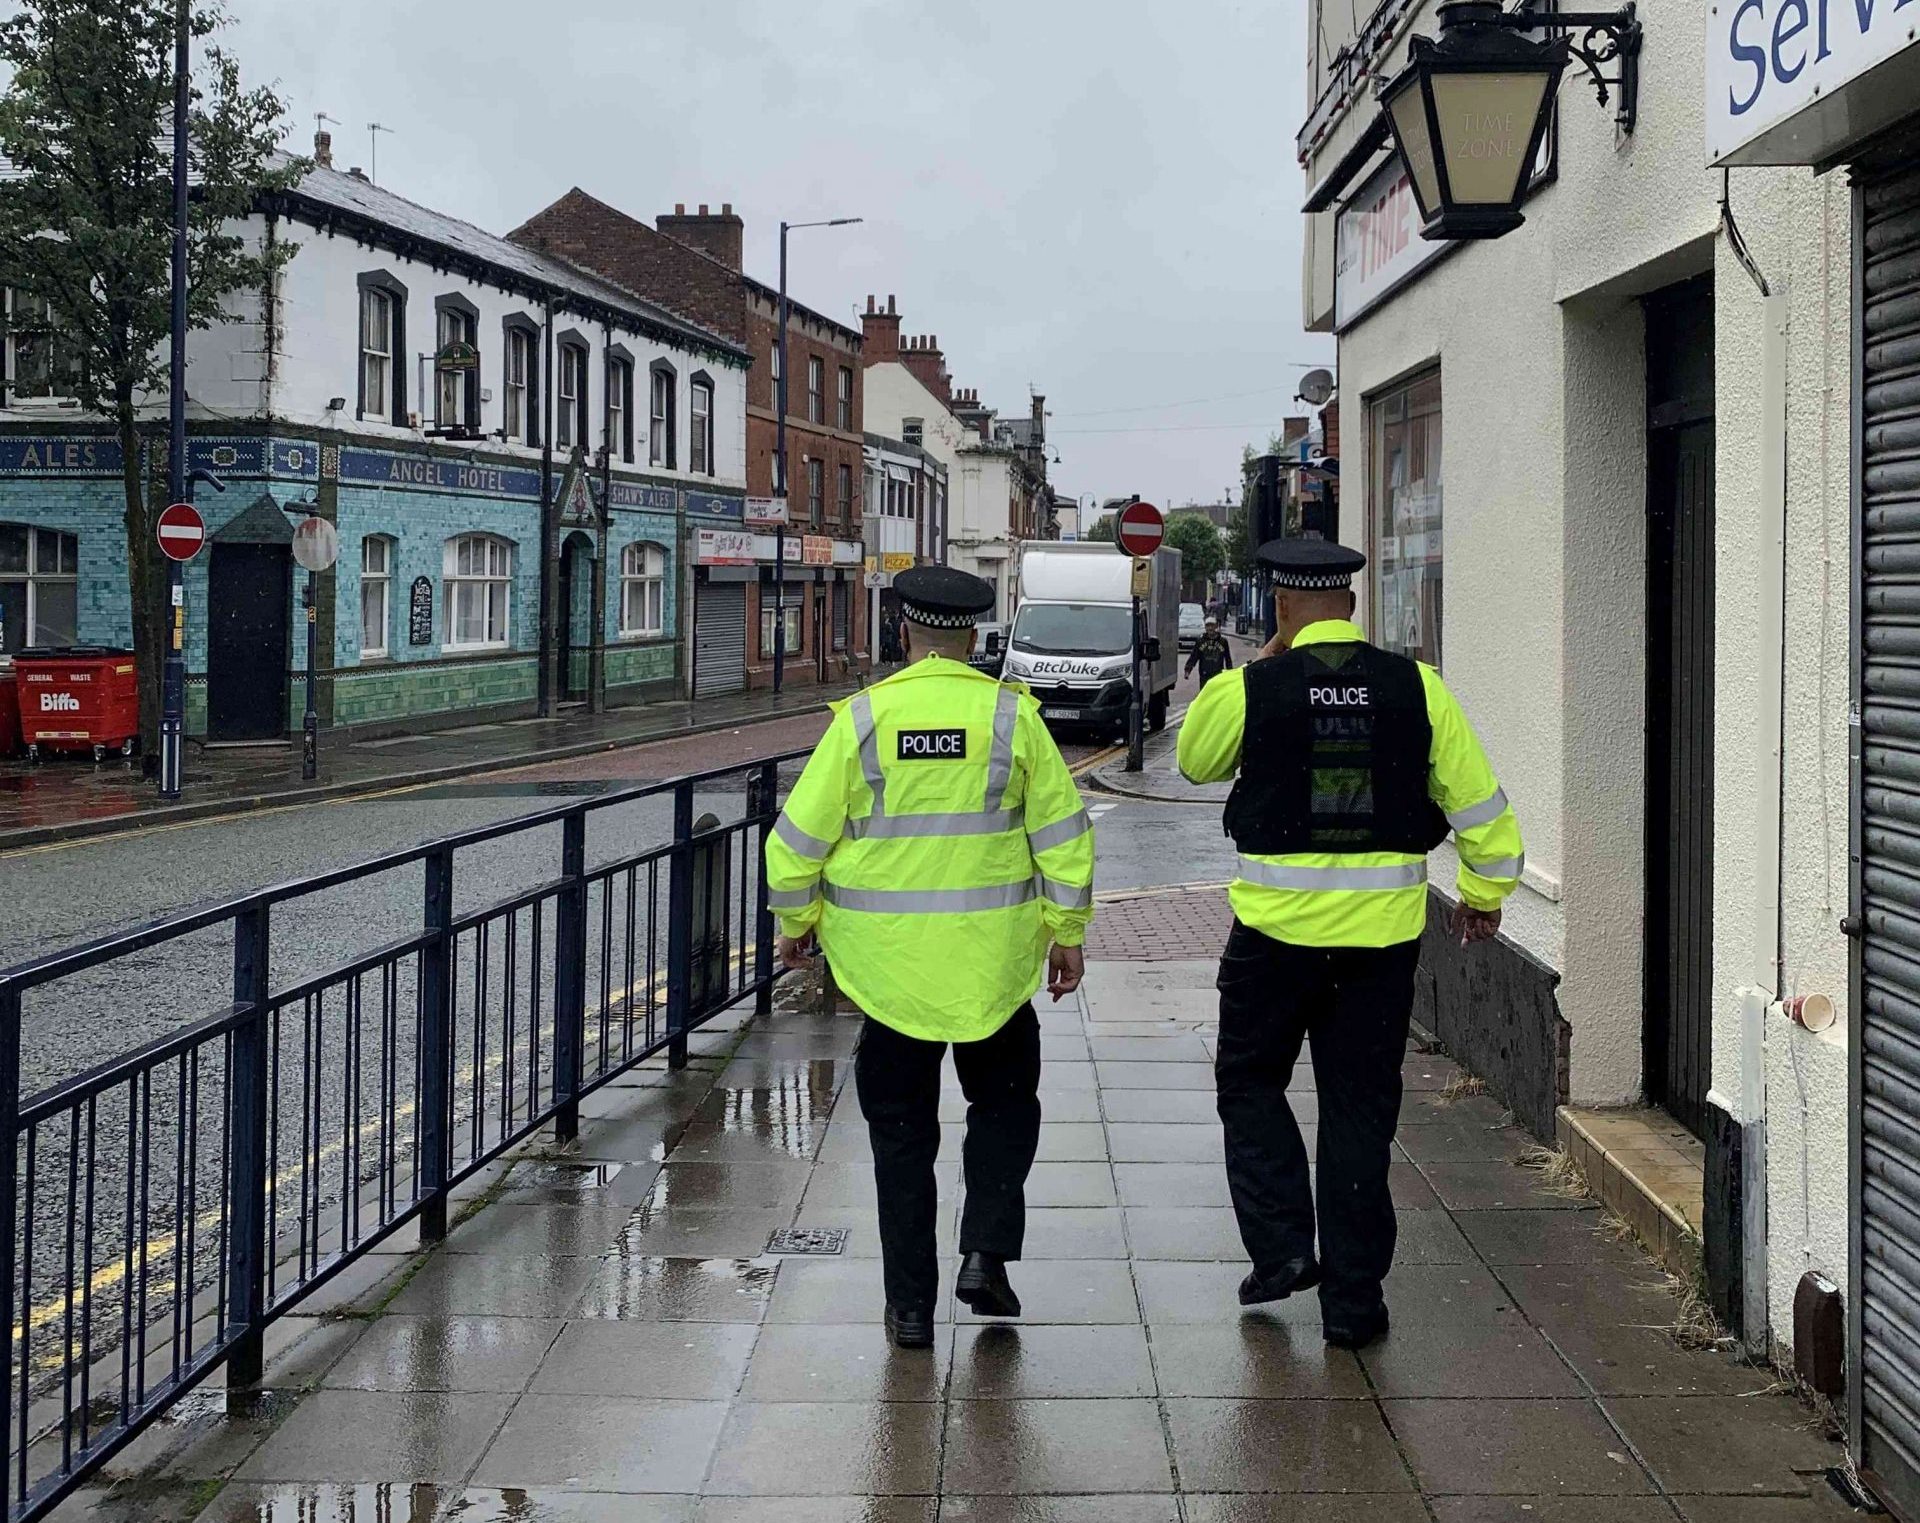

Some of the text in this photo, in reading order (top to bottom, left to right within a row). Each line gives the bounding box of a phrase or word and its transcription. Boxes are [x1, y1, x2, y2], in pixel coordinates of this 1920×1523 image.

[1463, 113, 1514, 132] TIME
[1457, 139, 1515, 158] ZONE
[1358, 173, 1411, 285] TIME
[21, 444, 97, 467] ALES
[389, 459, 505, 491] ANGEL HOTEL
[612, 486, 670, 508] SHAW'S ALES
[885, 558, 911, 567] PIZZA
[1032, 661, 1100, 675] BtcDuke
[27, 674, 91, 682] GENERAL WASTE
[40, 693, 80, 711] Biffa
[1309, 687, 1369, 705] POLICE
[902, 734, 961, 754] POLICE
